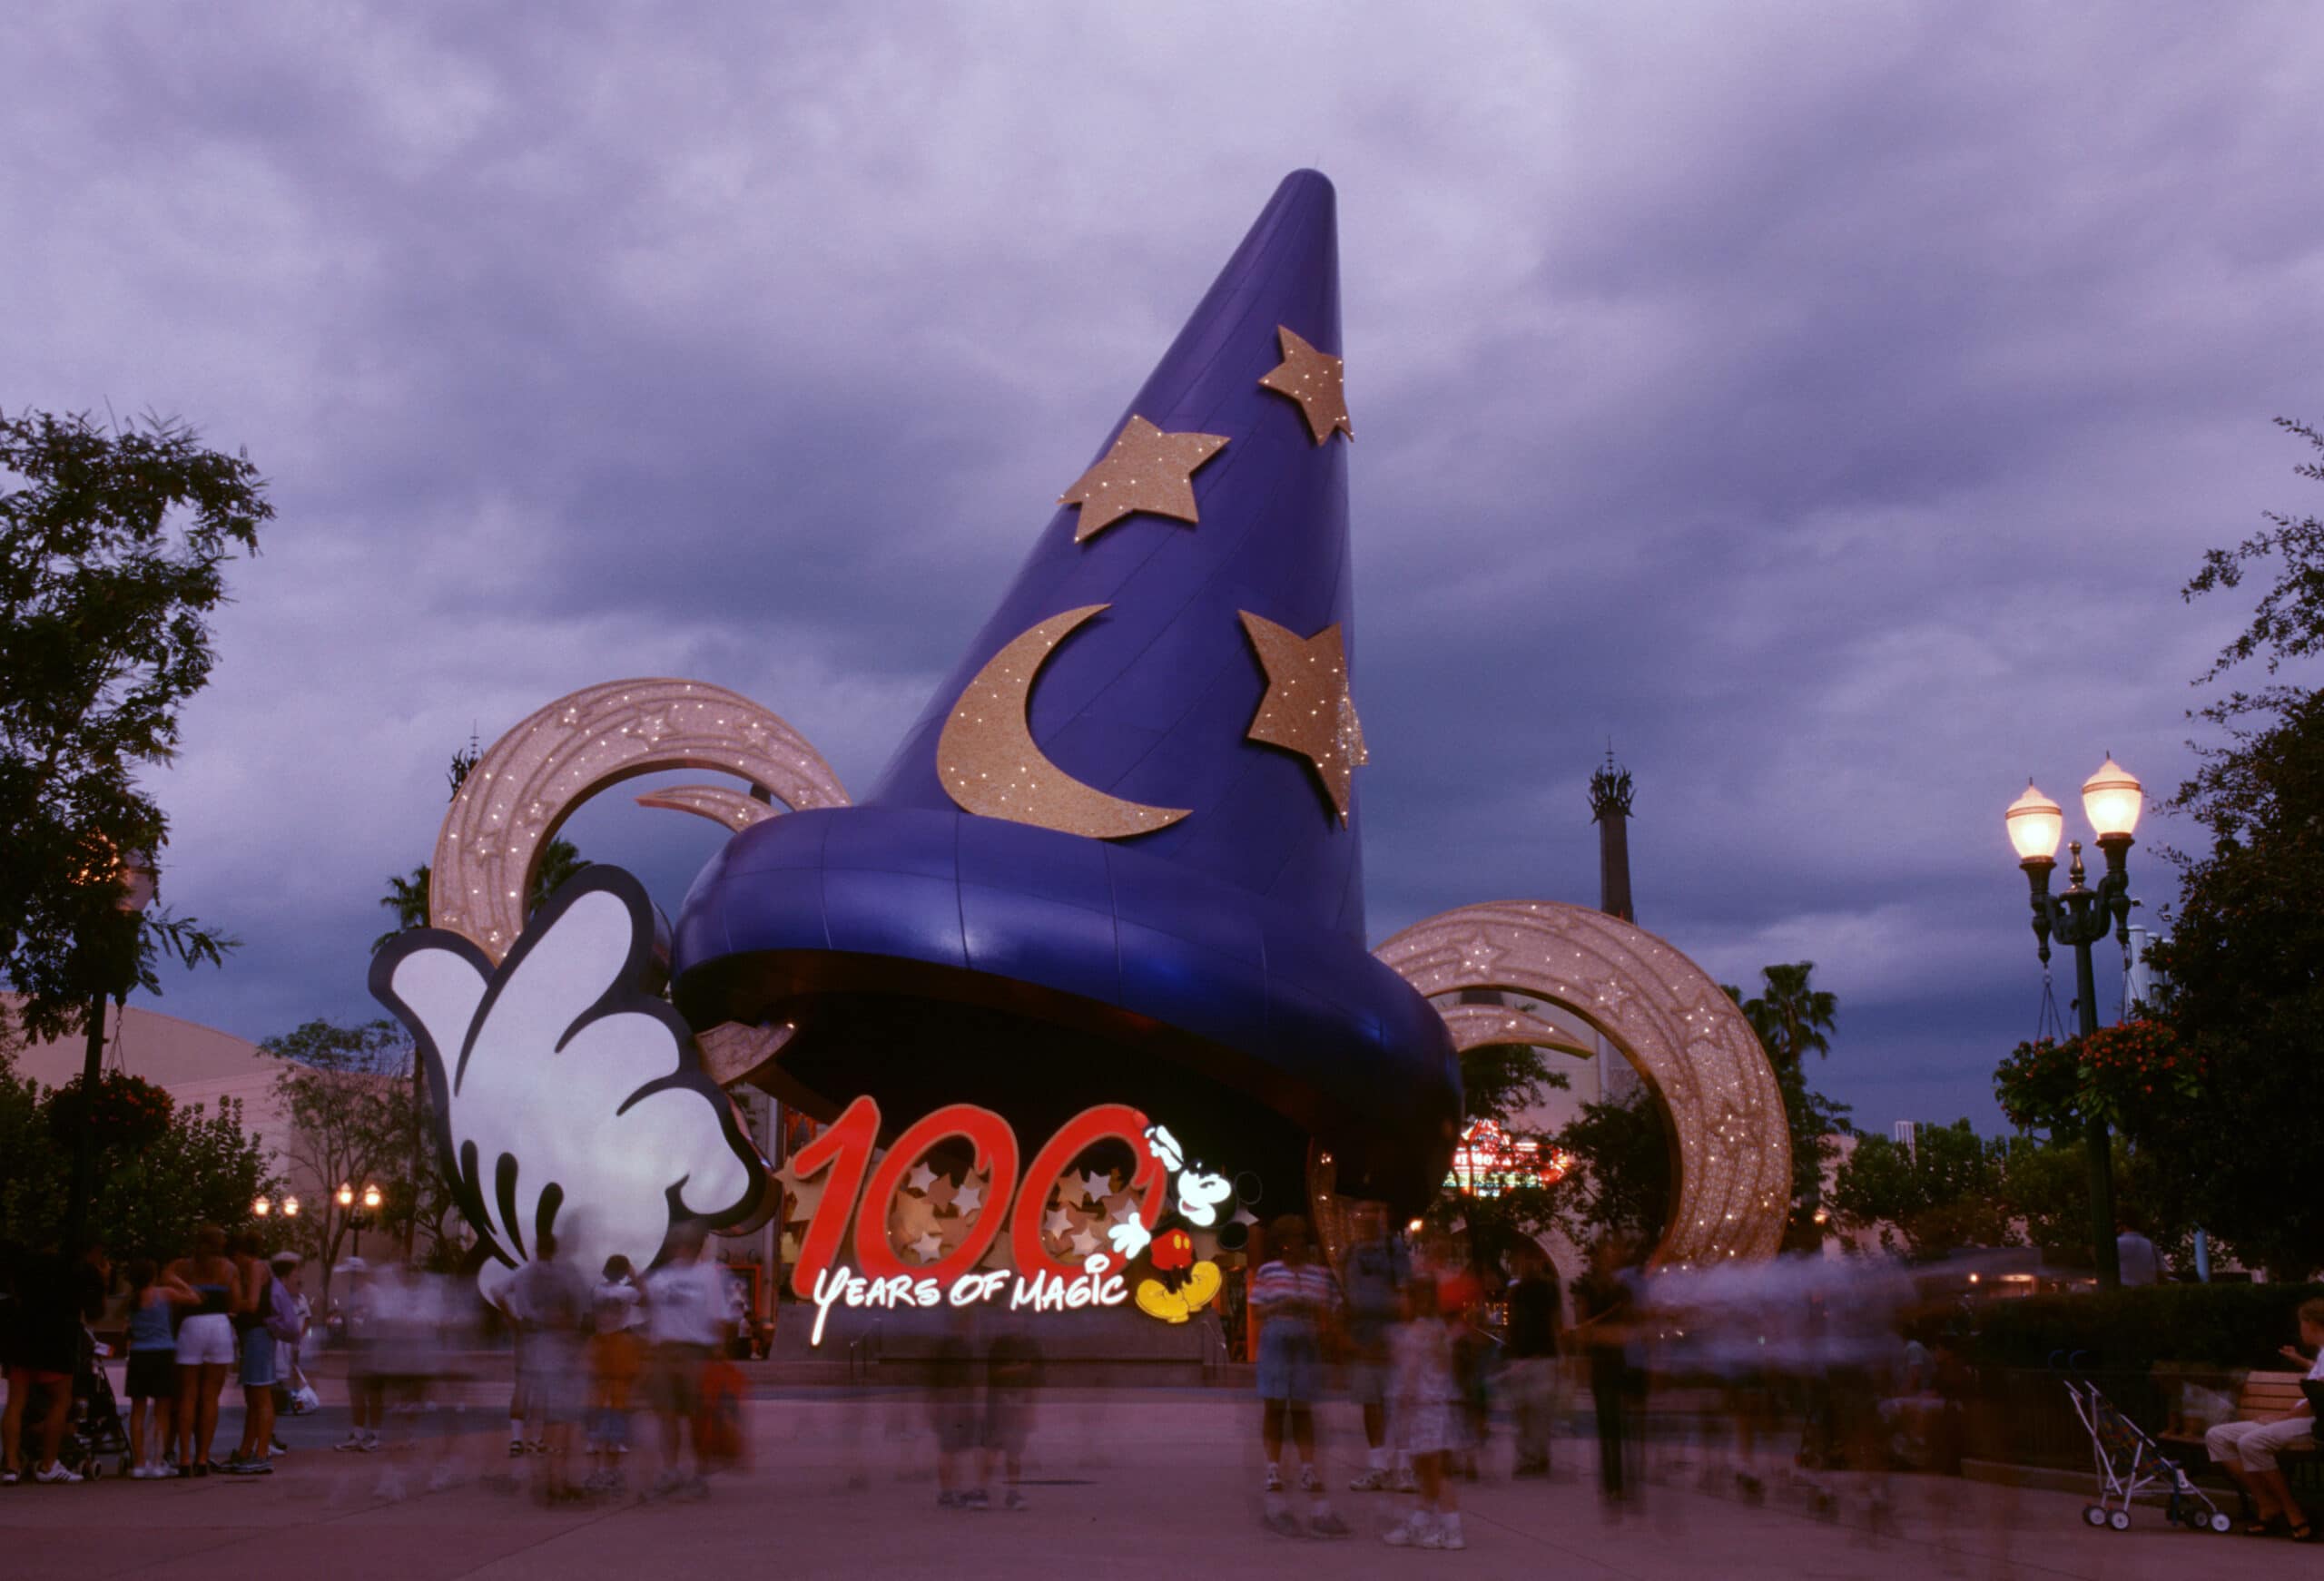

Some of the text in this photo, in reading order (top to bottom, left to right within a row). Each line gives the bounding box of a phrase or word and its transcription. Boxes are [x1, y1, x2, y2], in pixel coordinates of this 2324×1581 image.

[792, 1095, 1168, 1299] 100
[811, 1266, 941, 1345] YEARS
[949, 1269, 1011, 1307] OF
